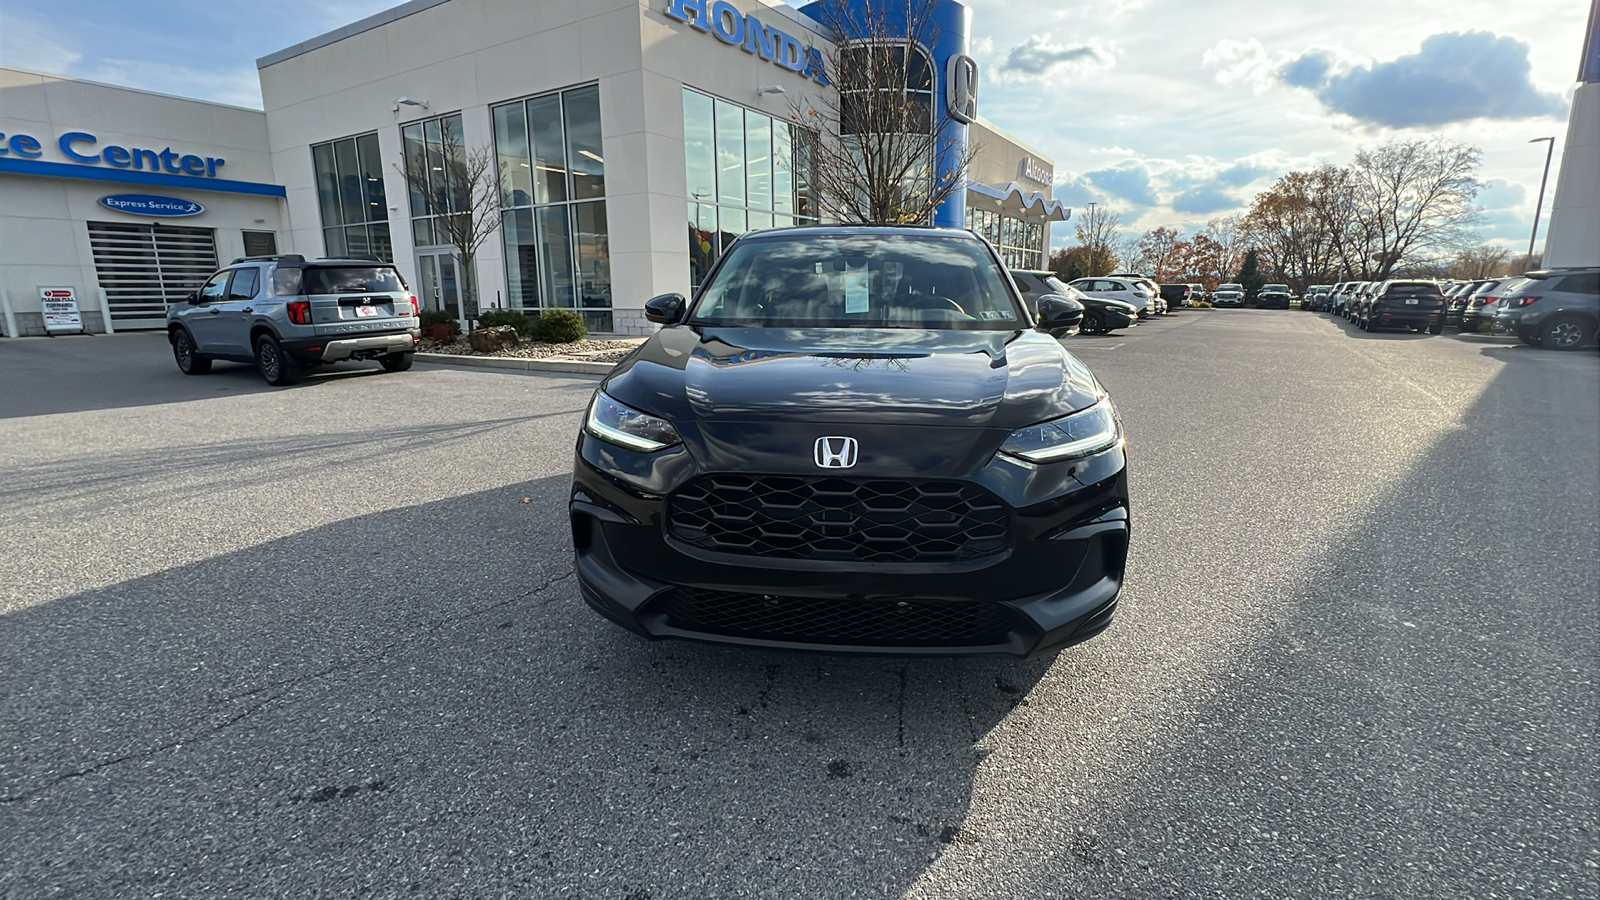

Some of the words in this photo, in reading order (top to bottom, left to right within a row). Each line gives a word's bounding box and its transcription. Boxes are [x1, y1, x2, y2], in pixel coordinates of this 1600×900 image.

[665, 0, 830, 86] HONDA
[59, 131, 226, 177] Center
[107, 198, 147, 208] Express
[149, 201, 184, 210] Service
